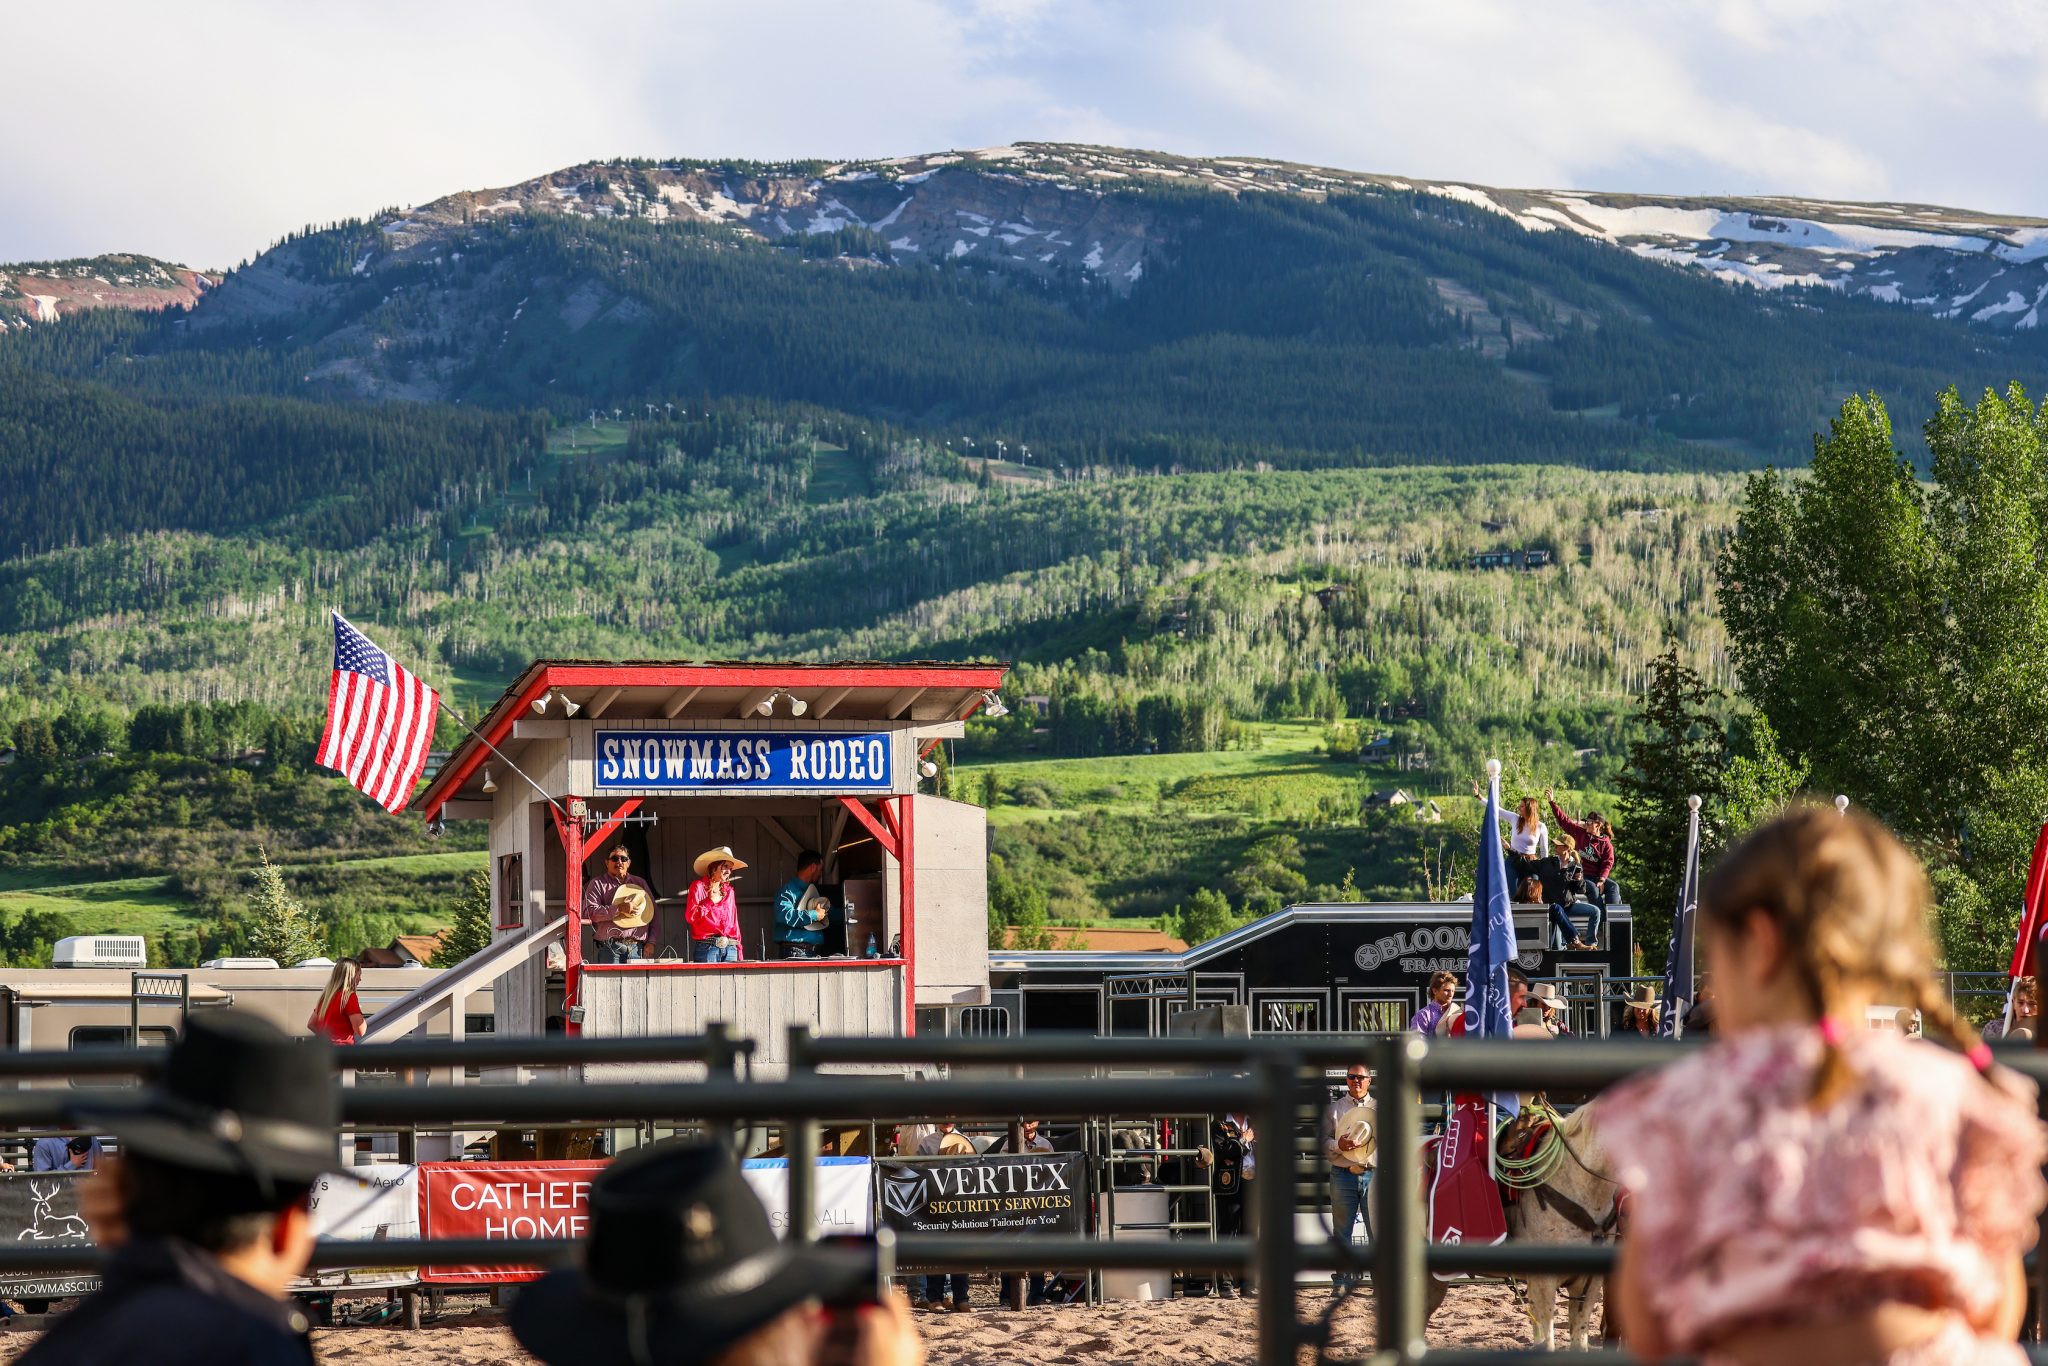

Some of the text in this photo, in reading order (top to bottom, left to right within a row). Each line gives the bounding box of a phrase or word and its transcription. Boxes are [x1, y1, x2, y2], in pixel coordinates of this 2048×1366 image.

[603, 738, 885, 780] SNOWMASS RODEO
[373, 1177, 405, 1188] Aero
[928, 1162, 1071, 1196] VERTEX
[929, 1195, 1072, 1215] SECURITY SERVICES
[951, 1219, 989, 1230] Solutions
[990, 1216, 1025, 1228] Tailored
[1025, 1216, 1037, 1226] for
